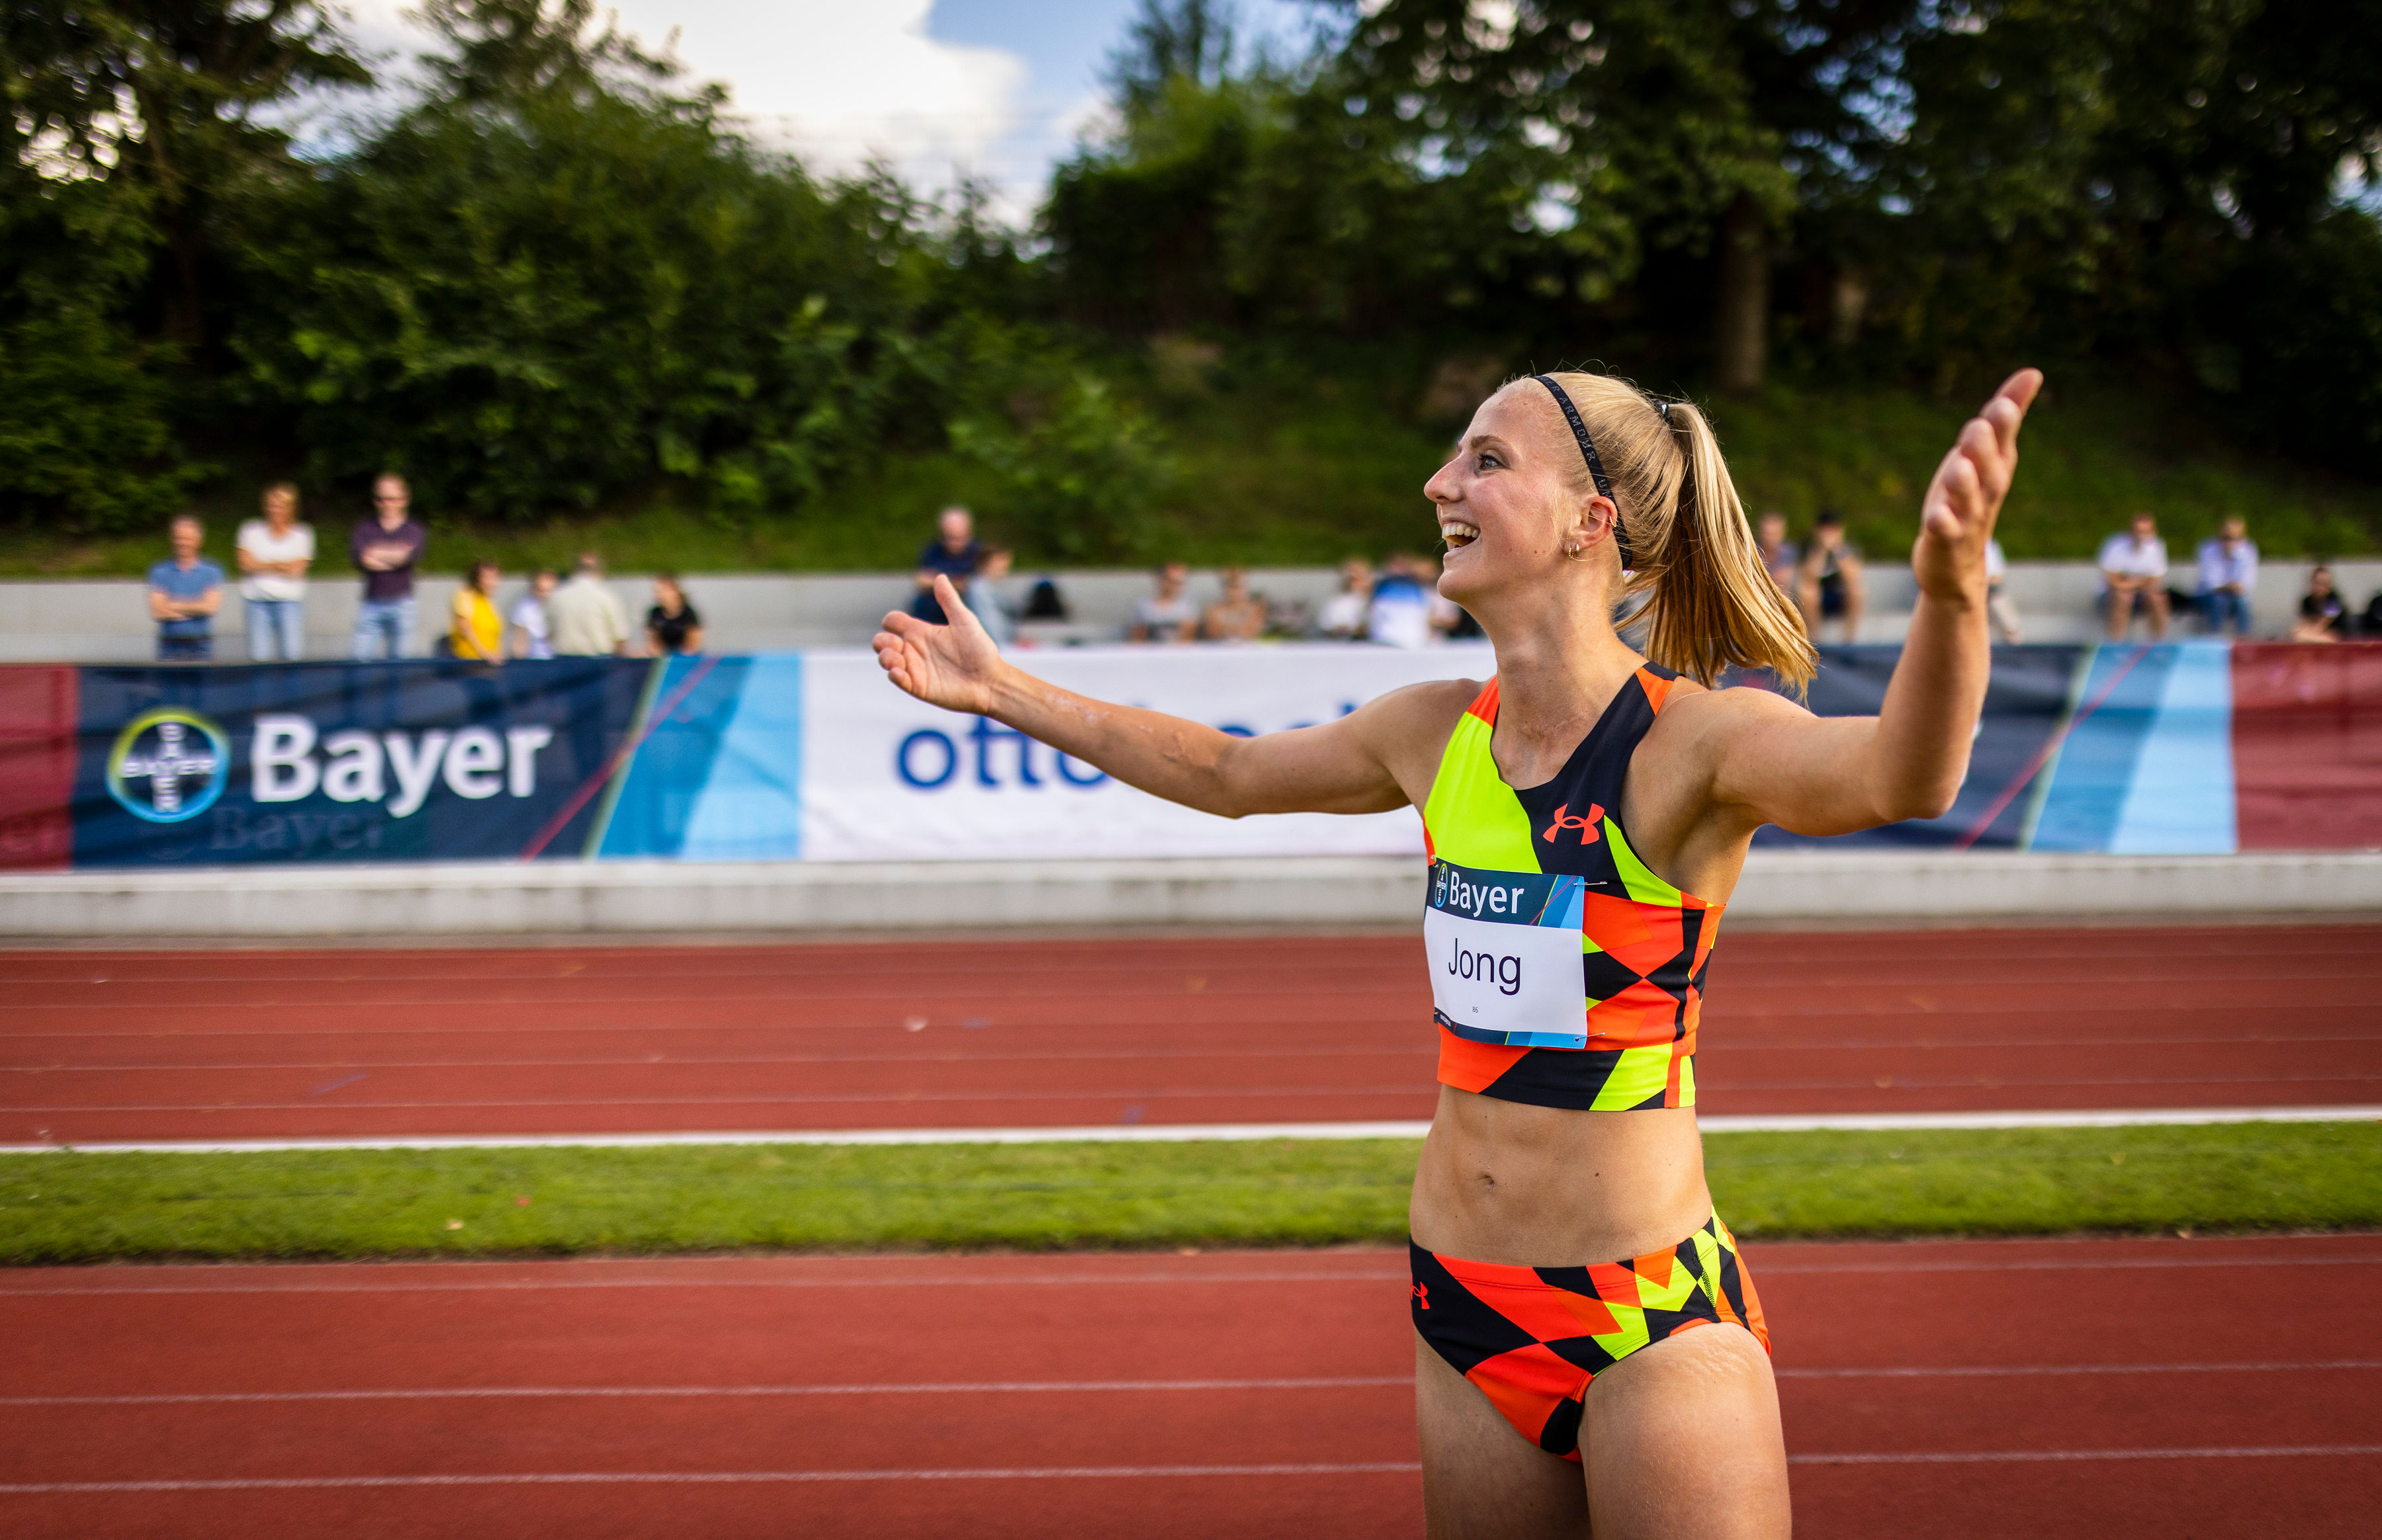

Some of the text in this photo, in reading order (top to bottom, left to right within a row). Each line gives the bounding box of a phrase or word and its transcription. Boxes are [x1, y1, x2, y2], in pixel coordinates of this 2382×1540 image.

[251, 716, 553, 818] Bayer
[1450, 871, 1524, 918] Bayer
[1448, 937, 1521, 996] Jong
